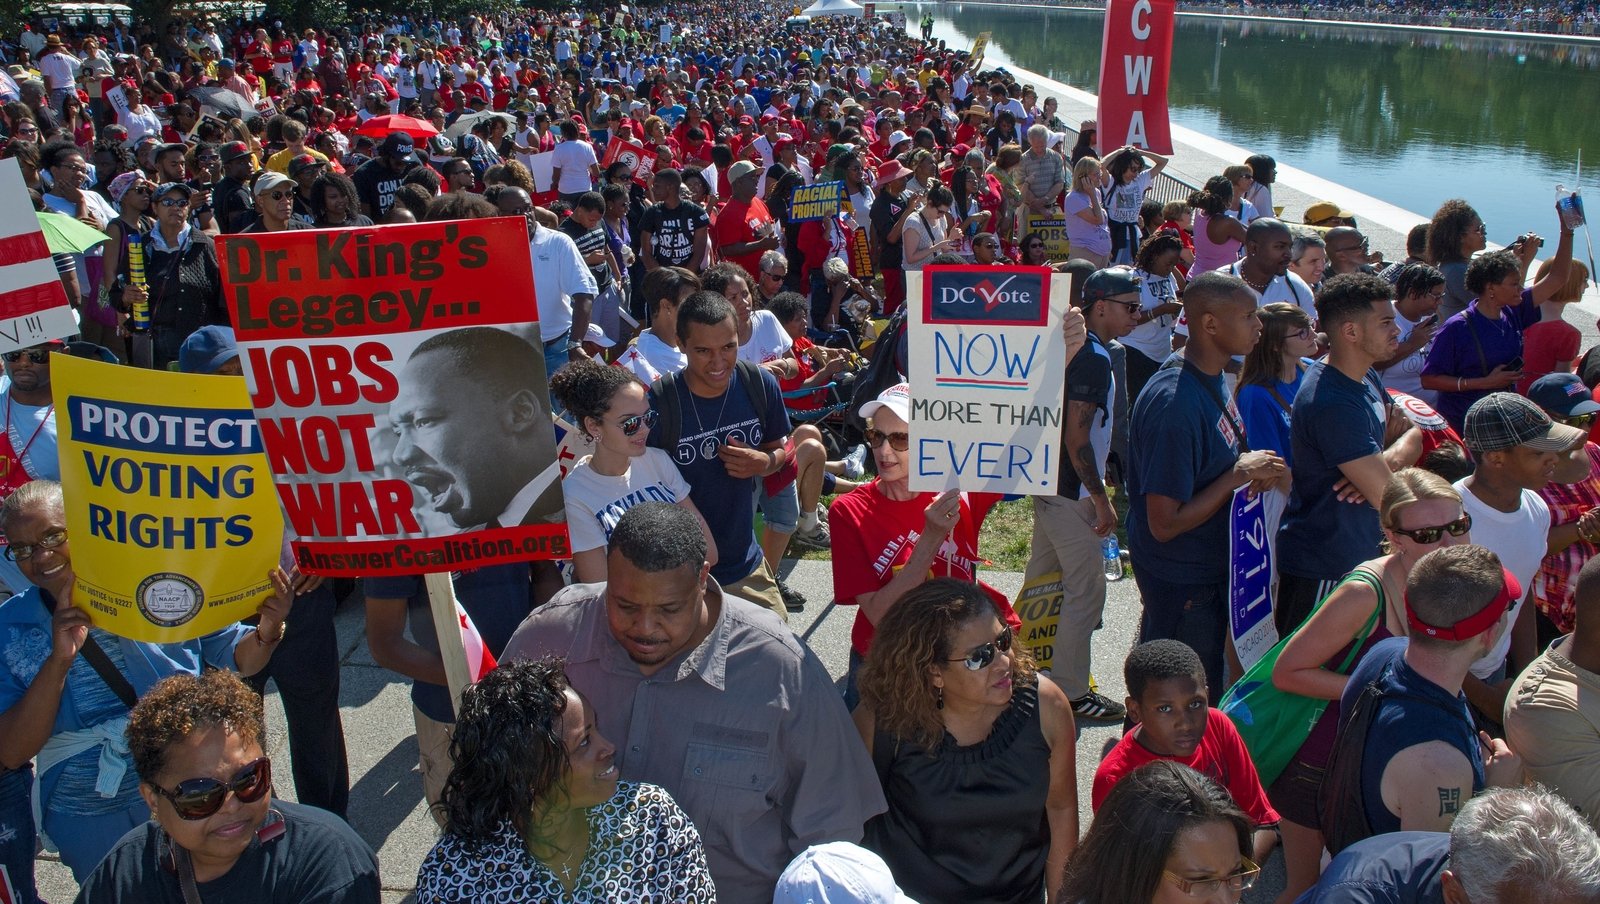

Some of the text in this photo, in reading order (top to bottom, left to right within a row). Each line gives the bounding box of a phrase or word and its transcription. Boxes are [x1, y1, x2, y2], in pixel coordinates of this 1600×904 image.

[1122, 0, 1154, 149] CWA
[791, 200, 838, 220] PROFILING
[792, 184, 838, 203] RACIAL
[225, 224, 489, 284] Dr. King's
[235, 285, 481, 336] Legacy...
[940, 286, 976, 304] DC
[247, 341, 400, 409] JOBS
[934, 331, 1041, 380] NOW
[80, 401, 257, 449] PROTECT
[679, 435, 694, 443] WARD
[694, 428, 720, 440] UNIVERSITY
[720, 422, 740, 432] STUDENT
[911, 398, 1062, 428] MORE THAN
[258, 413, 376, 475] NOT
[919, 438, 1050, 487] EVER!
[82, 449, 255, 499] VOTING
[88, 502, 254, 550] RIGHTS
[276, 479, 422, 537] WAR
[297, 534, 567, 570] AnswerCoalition.org
[873, 540, 900, 577] ARCH
[87, 585, 107, 601] JUSTICE
[1019, 594, 1065, 621] JOB
[1027, 585, 1042, 597] WE
[1027, 624, 1058, 641] AND
